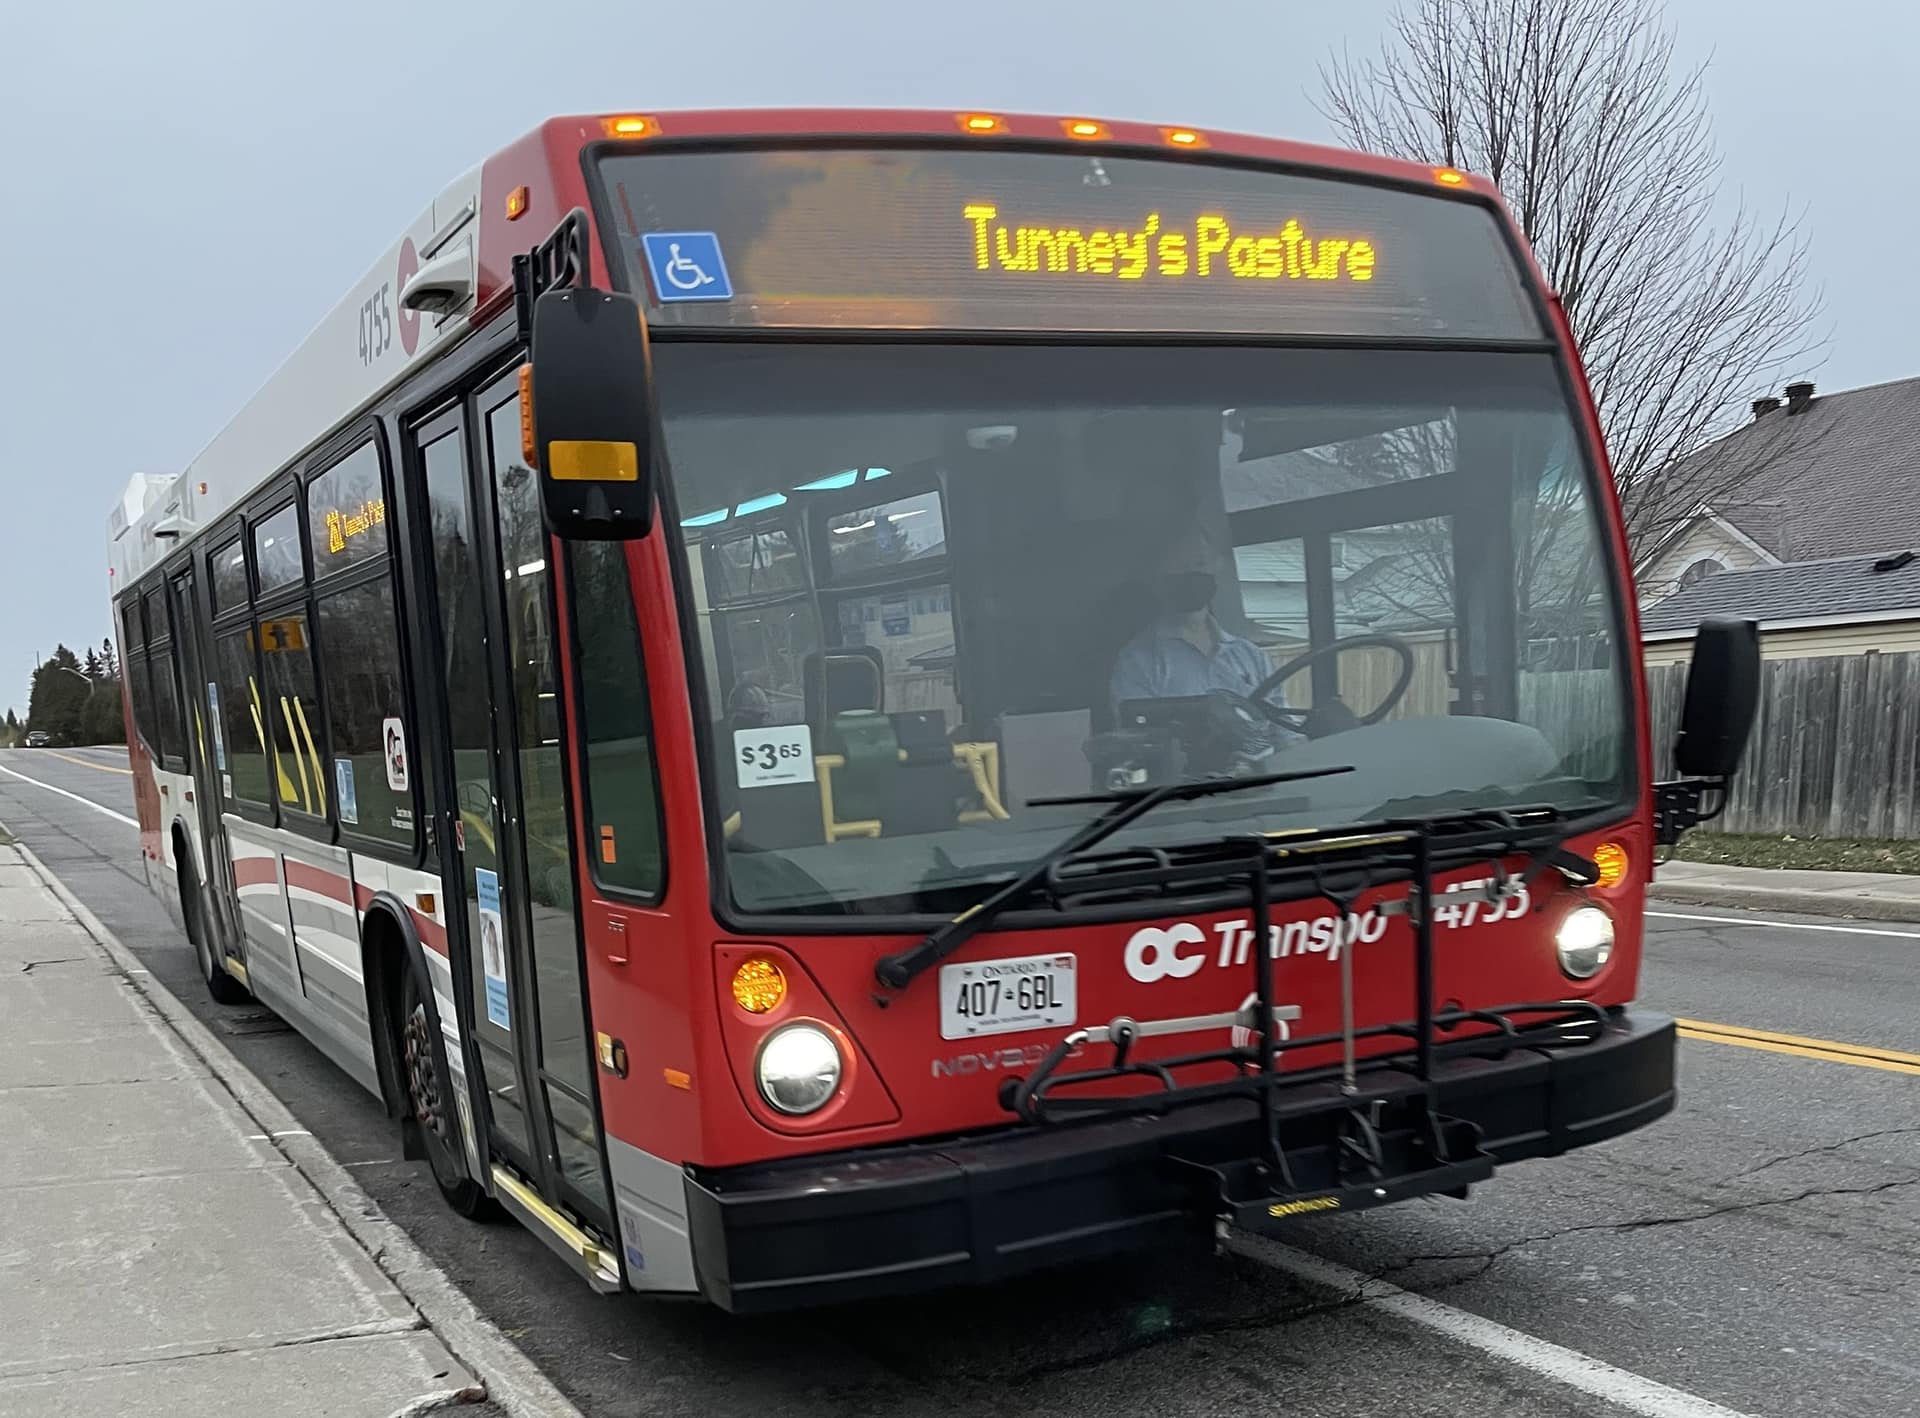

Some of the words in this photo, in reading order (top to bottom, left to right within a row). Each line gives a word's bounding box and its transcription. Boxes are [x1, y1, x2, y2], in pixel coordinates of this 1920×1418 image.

[963, 204, 1188, 279] Tunney's
[1196, 215, 1375, 281] Pasture
[360, 281, 391, 368] 4755
[1124, 923, 1206, 983] OC
